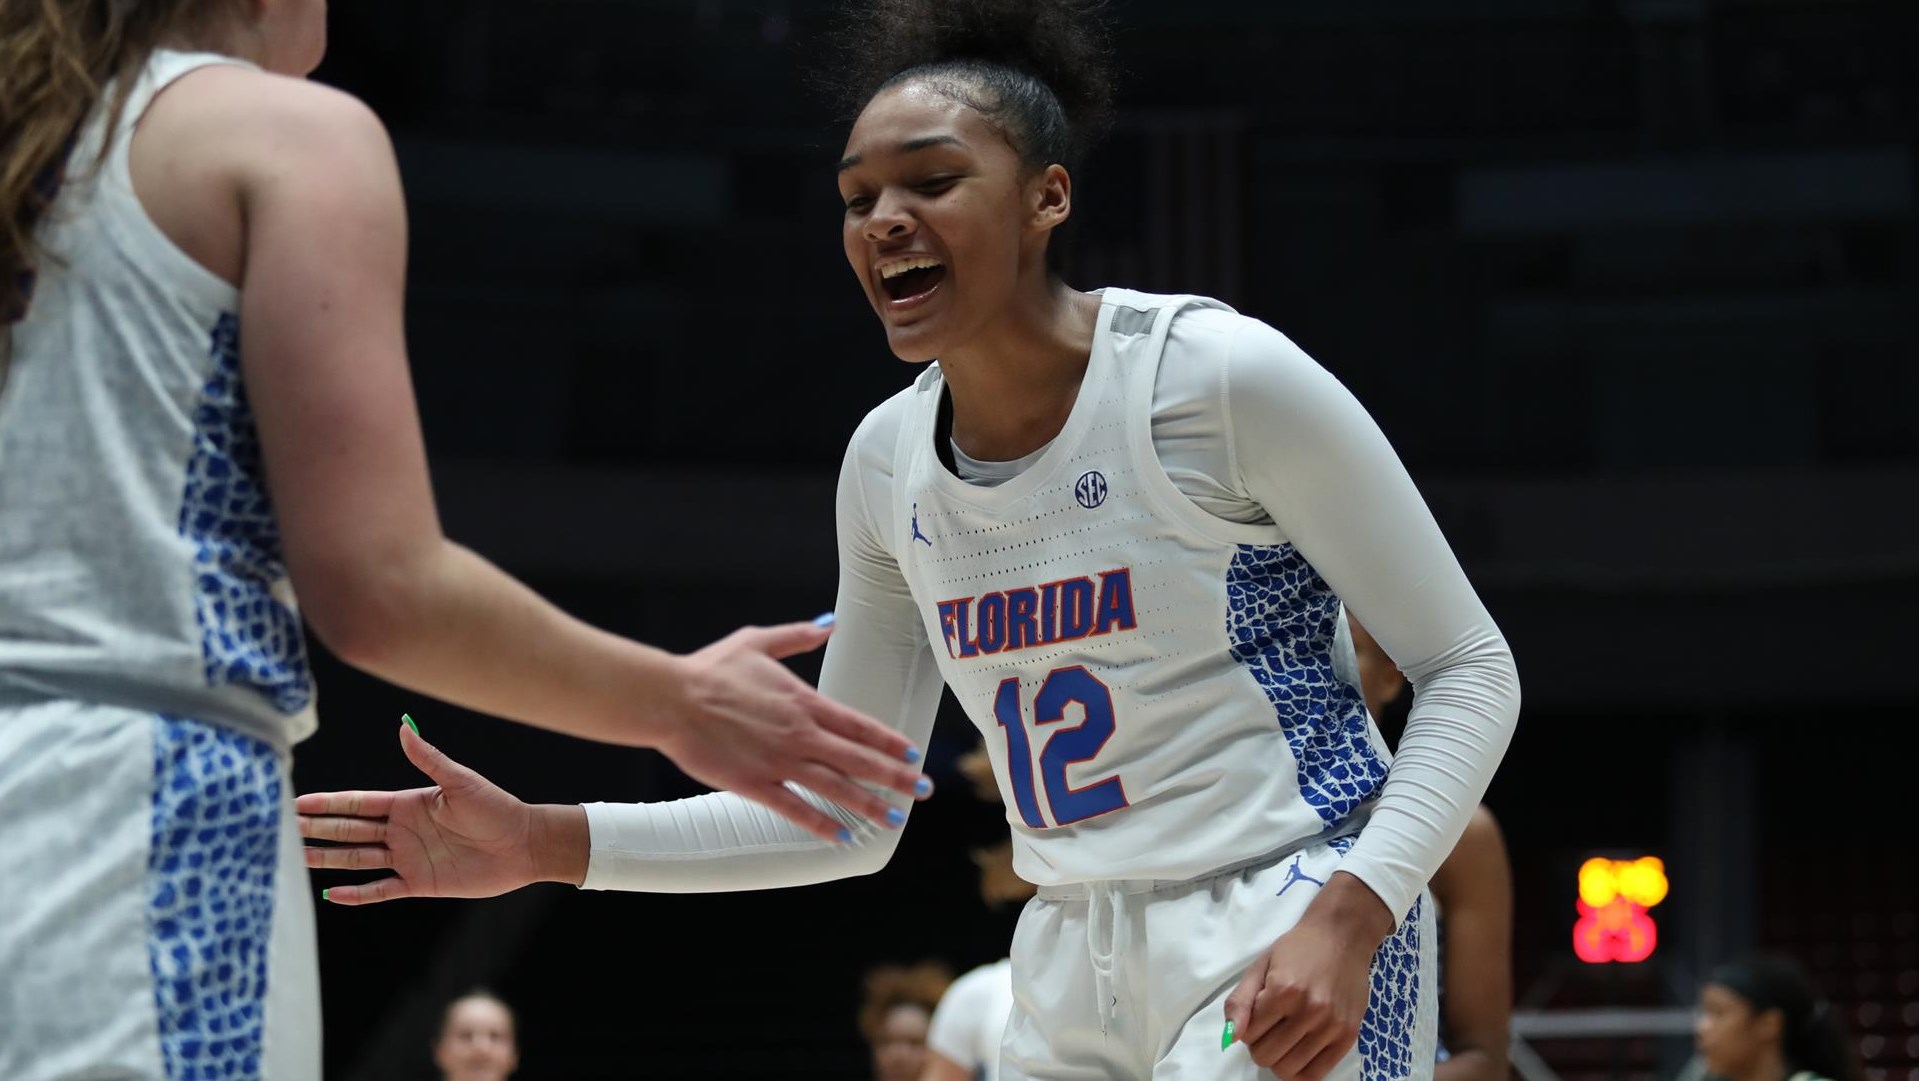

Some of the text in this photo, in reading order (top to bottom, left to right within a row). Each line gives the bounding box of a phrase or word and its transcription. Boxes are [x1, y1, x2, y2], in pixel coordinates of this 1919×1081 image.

[1076, 471, 1106, 508] SEC
[936, 567, 1137, 659] FLORIDA
[993, 665, 1130, 828] 12
